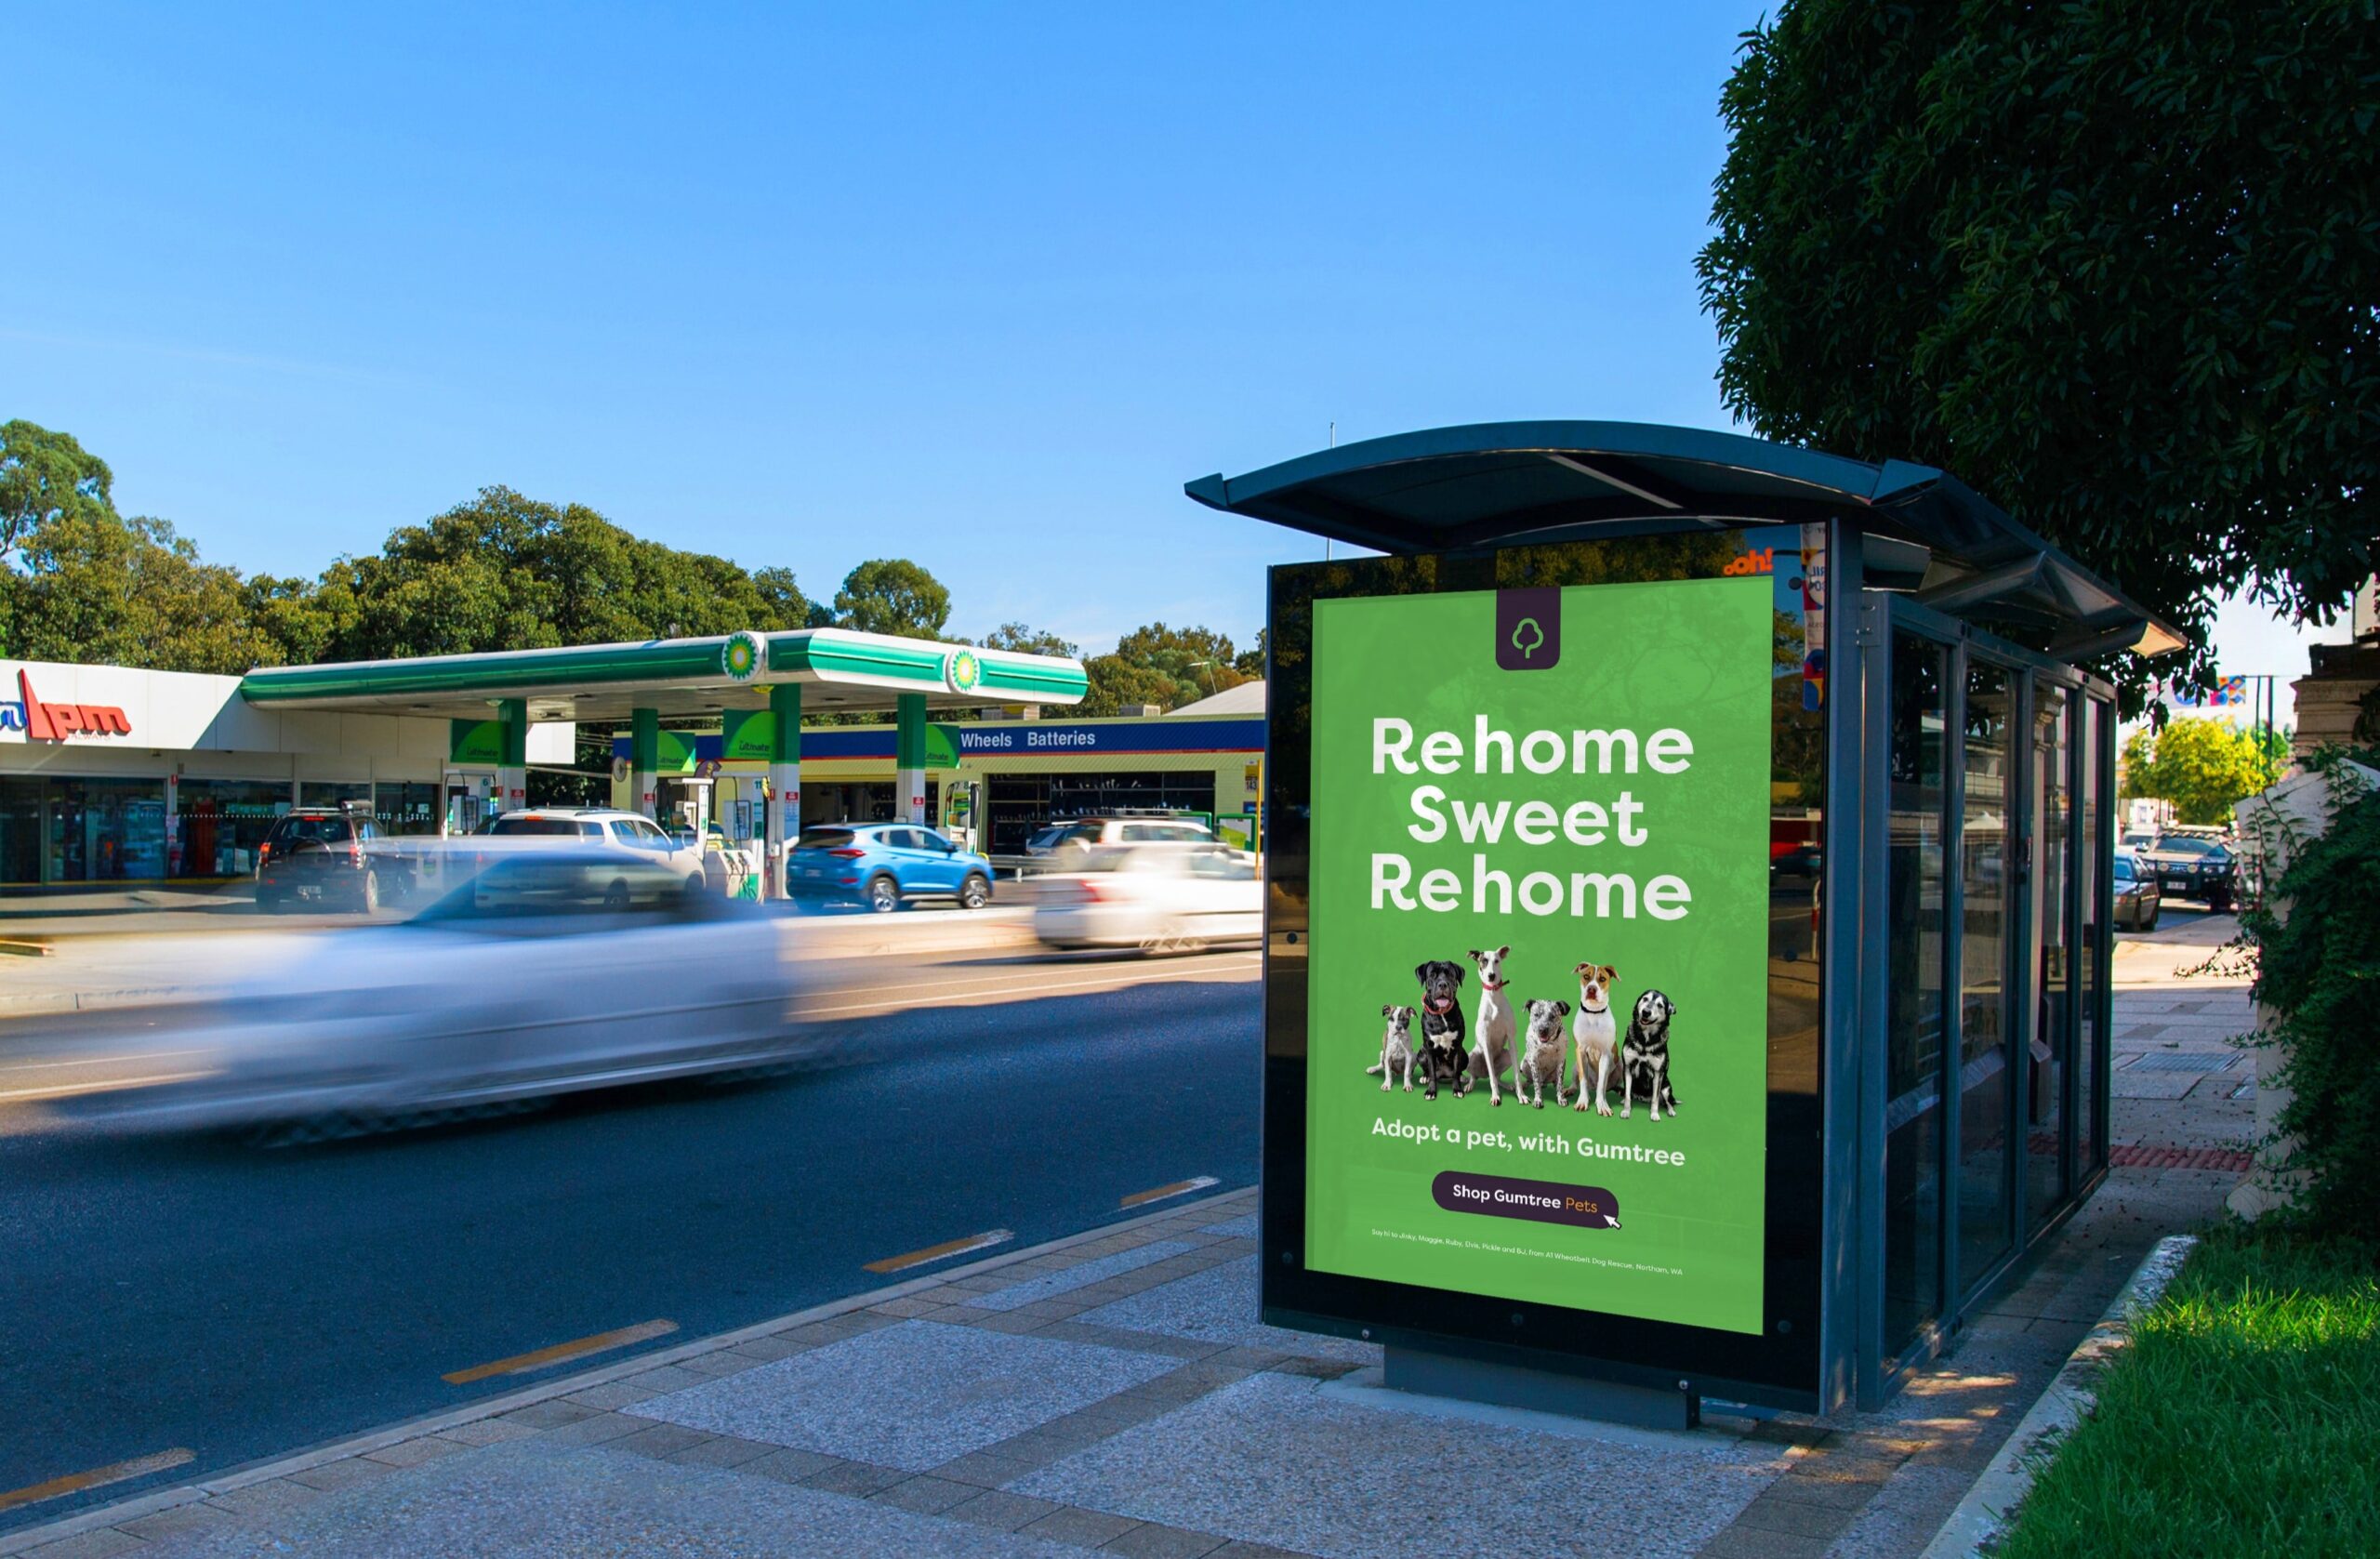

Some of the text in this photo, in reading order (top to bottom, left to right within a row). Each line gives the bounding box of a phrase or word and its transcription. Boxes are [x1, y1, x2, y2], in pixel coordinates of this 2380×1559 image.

[960, 730, 1095, 747] Wheels Batteries
[1372, 714, 1694, 775] Rehome
[1407, 785, 1648, 847] Sweet
[1370, 852, 1692, 921] Rehome
[1371, 1117, 1686, 1166] Adopt a pet, with Gumtree
[1453, 1184, 1598, 1213] Shop Gumtree Pets
[1371, 1228, 1382, 1237] Say
[1398, 1233, 1417, 1242] Jinky,
[1419, 1235, 1445, 1245] Maggie,
[1446, 1238, 1463, 1248] Ruby,
[1465, 1241, 1481, 1249] Elvis,
[1482, 1243, 1501, 1251] Pickle
[1501, 1245, 1515, 1253] and
[1528, 1249, 1544, 1257] from
[1554, 1252, 1591, 1263] Wheatbelt
[1592, 1258, 1606, 1267] Dog
[1607, 1260, 1634, 1270] Rescue,
[1636, 1263, 1669, 1275] Northam,
